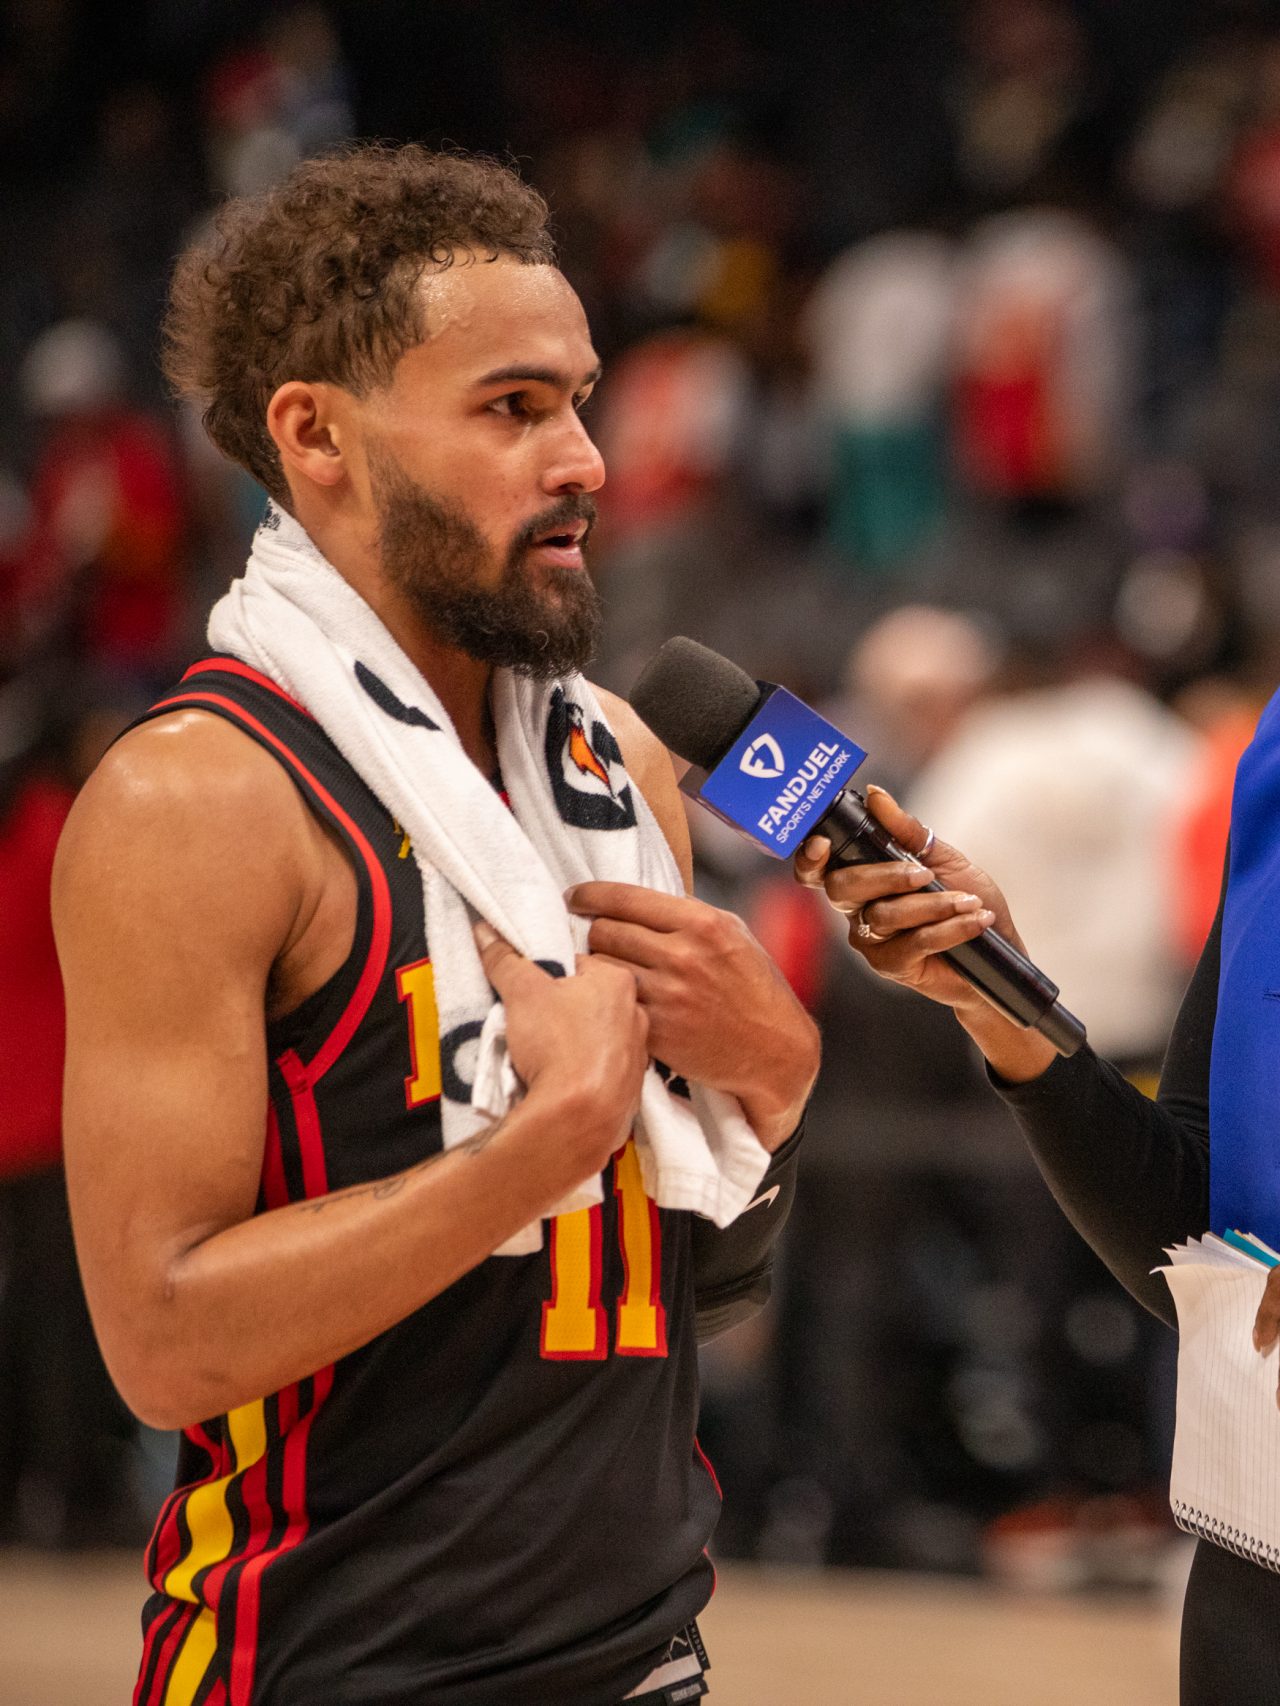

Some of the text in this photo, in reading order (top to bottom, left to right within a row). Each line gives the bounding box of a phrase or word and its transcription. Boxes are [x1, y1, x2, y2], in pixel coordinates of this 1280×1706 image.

[757, 742, 839, 835] FANDUEL
[776, 750, 851, 843] SPORTS NETWORK
[539, 1128, 669, 1361] 11
